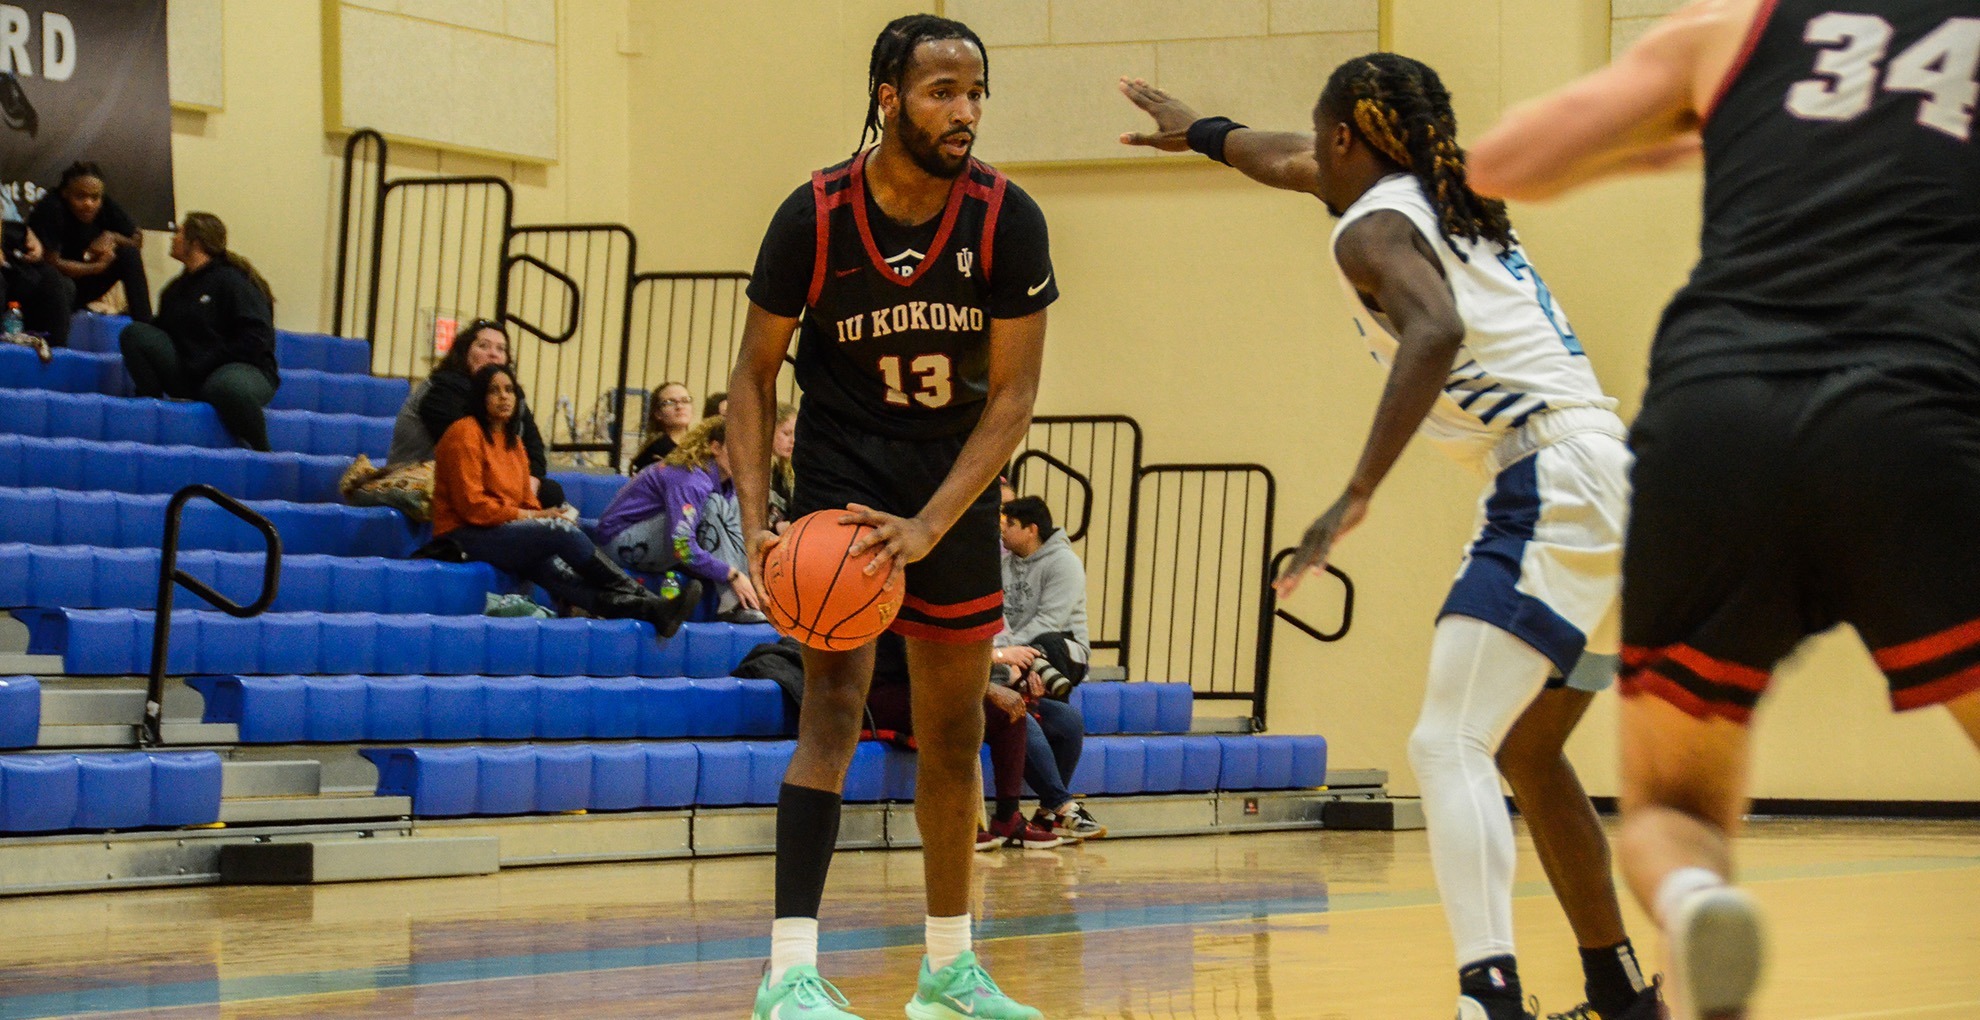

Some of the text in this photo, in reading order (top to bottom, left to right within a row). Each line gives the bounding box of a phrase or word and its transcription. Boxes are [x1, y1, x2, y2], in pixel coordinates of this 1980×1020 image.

[1785, 11, 1980, 142] 34
[836, 301, 984, 343] IU KOKOMO
[878, 353, 953, 410] 13
